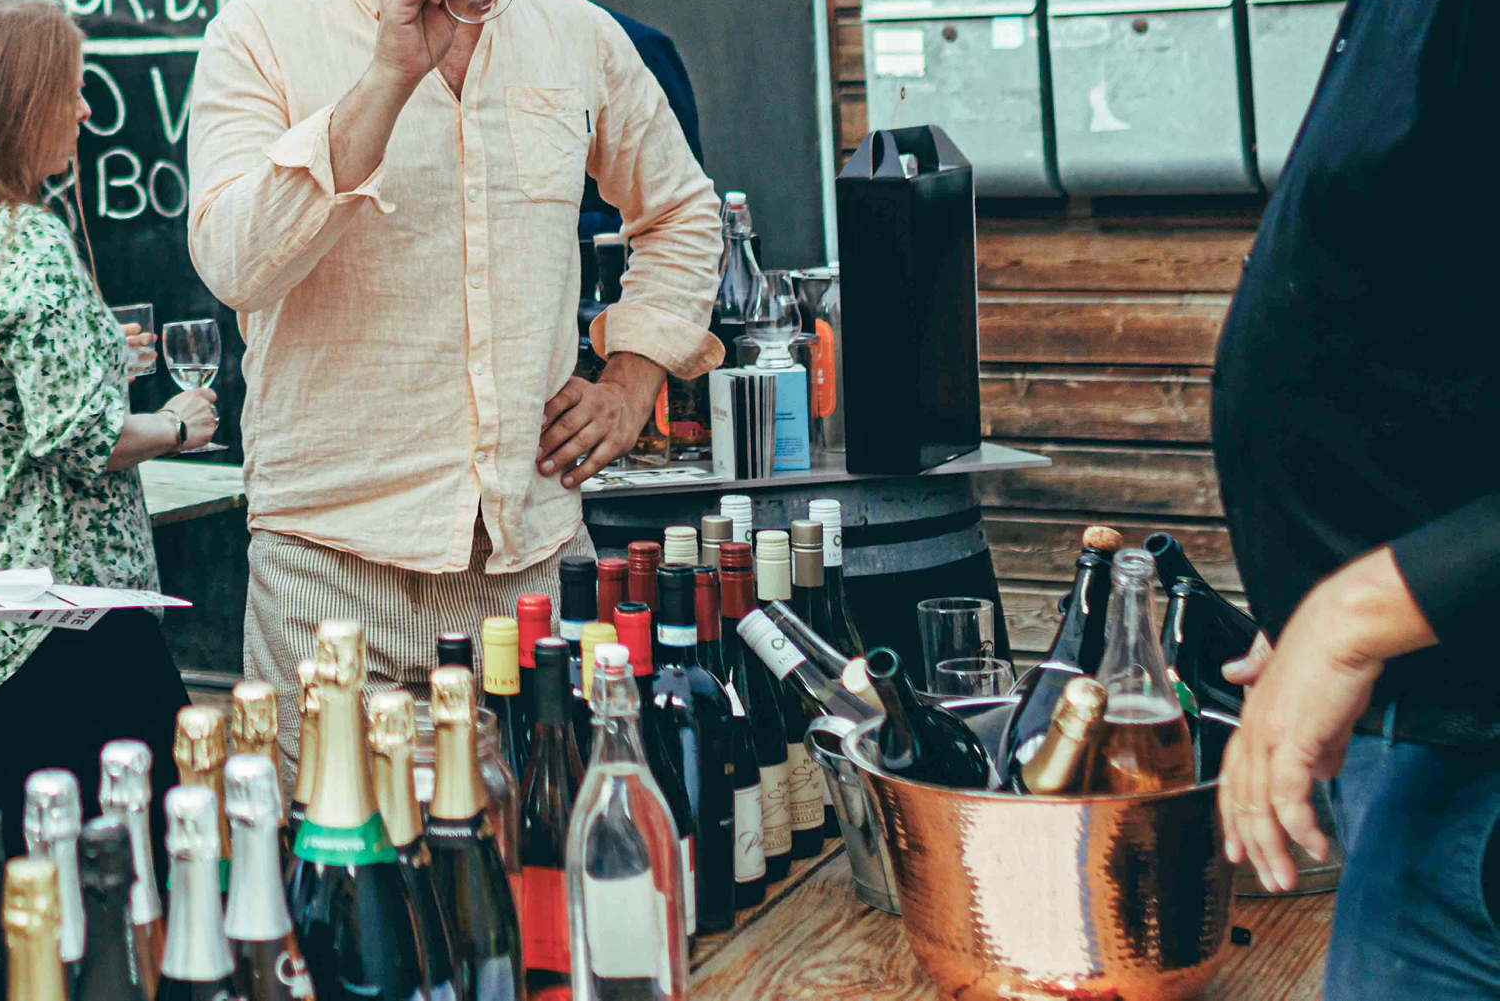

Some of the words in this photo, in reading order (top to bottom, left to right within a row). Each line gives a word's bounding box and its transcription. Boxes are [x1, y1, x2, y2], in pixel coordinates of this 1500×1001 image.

[97, 147, 190, 220] BO
[430, 825, 473, 838] CHARPENTIER
[312, 837, 366, 851] CHARPENTIER
